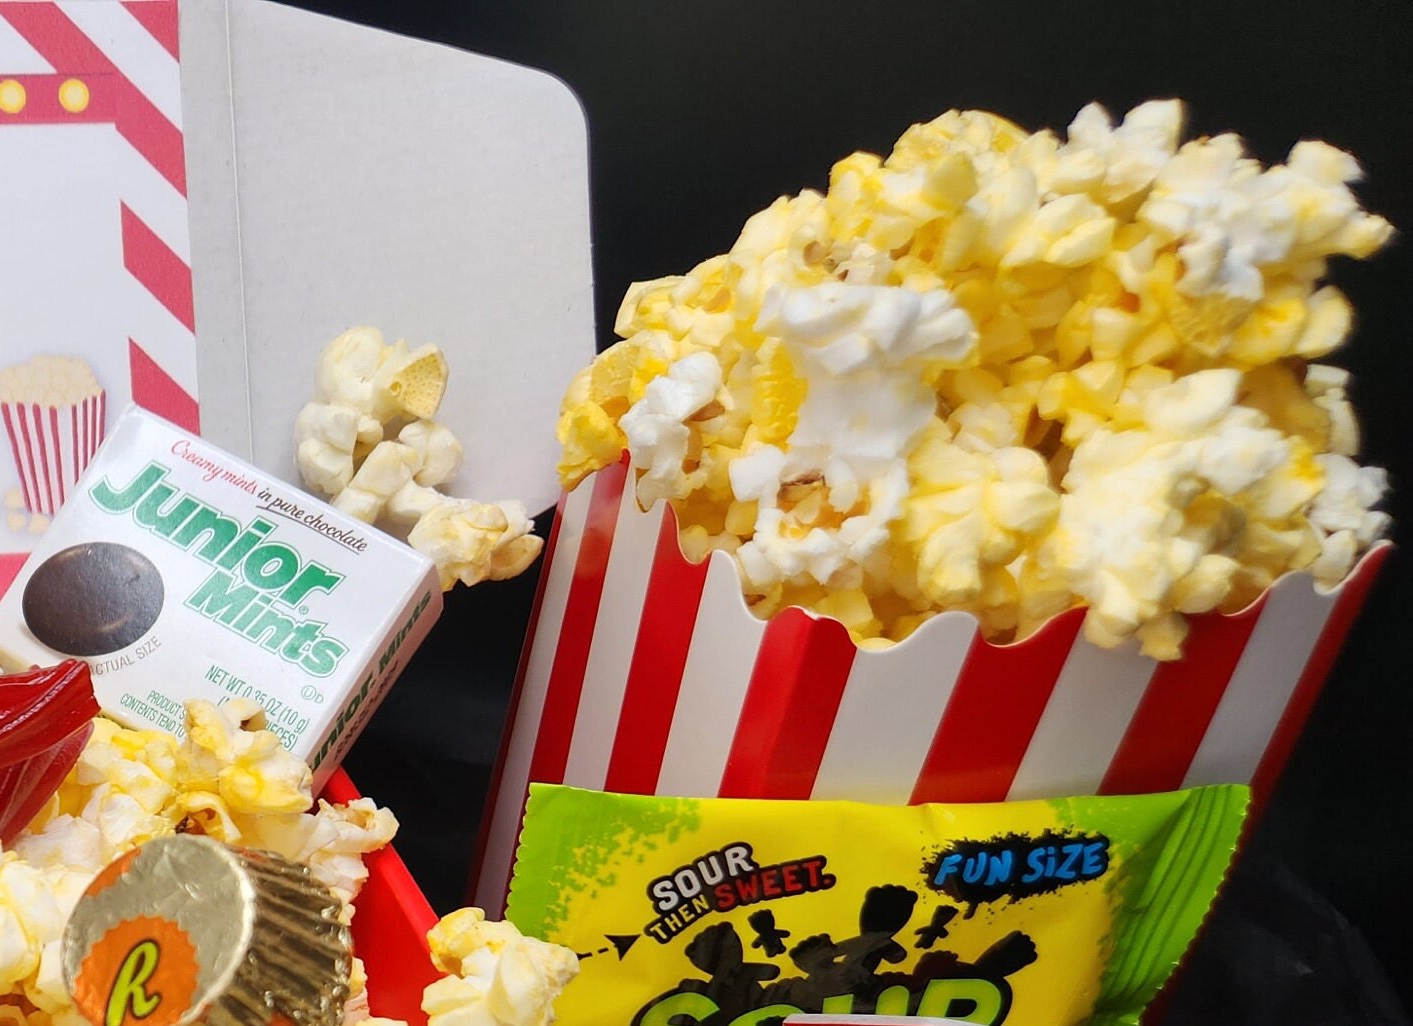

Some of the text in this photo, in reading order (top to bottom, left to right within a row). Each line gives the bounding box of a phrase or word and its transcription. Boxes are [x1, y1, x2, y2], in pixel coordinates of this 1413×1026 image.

[171, 440, 369, 552] Creamy mints in pure chocolate
[88, 460, 347, 610] Junior
[183, 566, 350, 678] Mints
[136, 635, 162, 659] SIZE
[147, 690, 181, 714] PRODUCT
[204, 663, 229, 691] NET
[228, 673, 246, 695] WT
[120, 692, 158, 722] CONTENTS
[155, 712, 178, 732] TEND
[311, 671, 376, 774] unior
[652, 845, 754, 912] SOUR
[933, 847, 1012, 888] FUN
[649, 894, 710, 940] THEN
